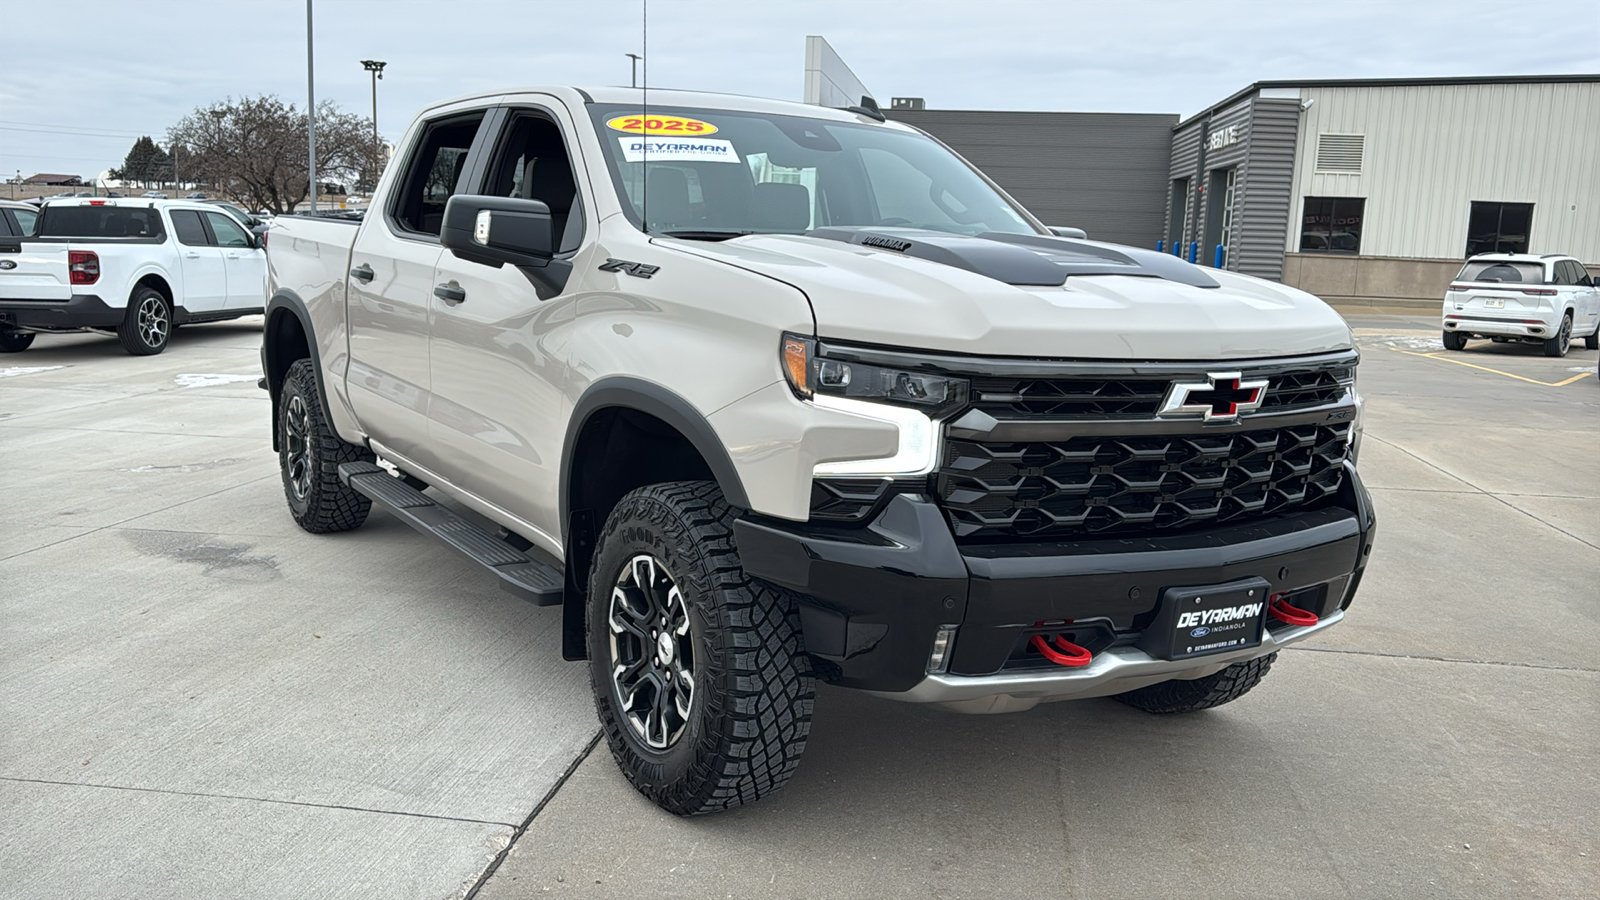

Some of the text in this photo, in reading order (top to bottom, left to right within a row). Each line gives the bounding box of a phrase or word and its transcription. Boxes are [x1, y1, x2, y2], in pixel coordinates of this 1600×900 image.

[622, 118, 704, 132] 2025
[630, 143, 727, 152] DEYARMAN
[598, 257, 660, 279] ZR2
[1177, 602, 1263, 628] DEYARMAN
[1211, 622, 1246, 633] INDIANOLA
